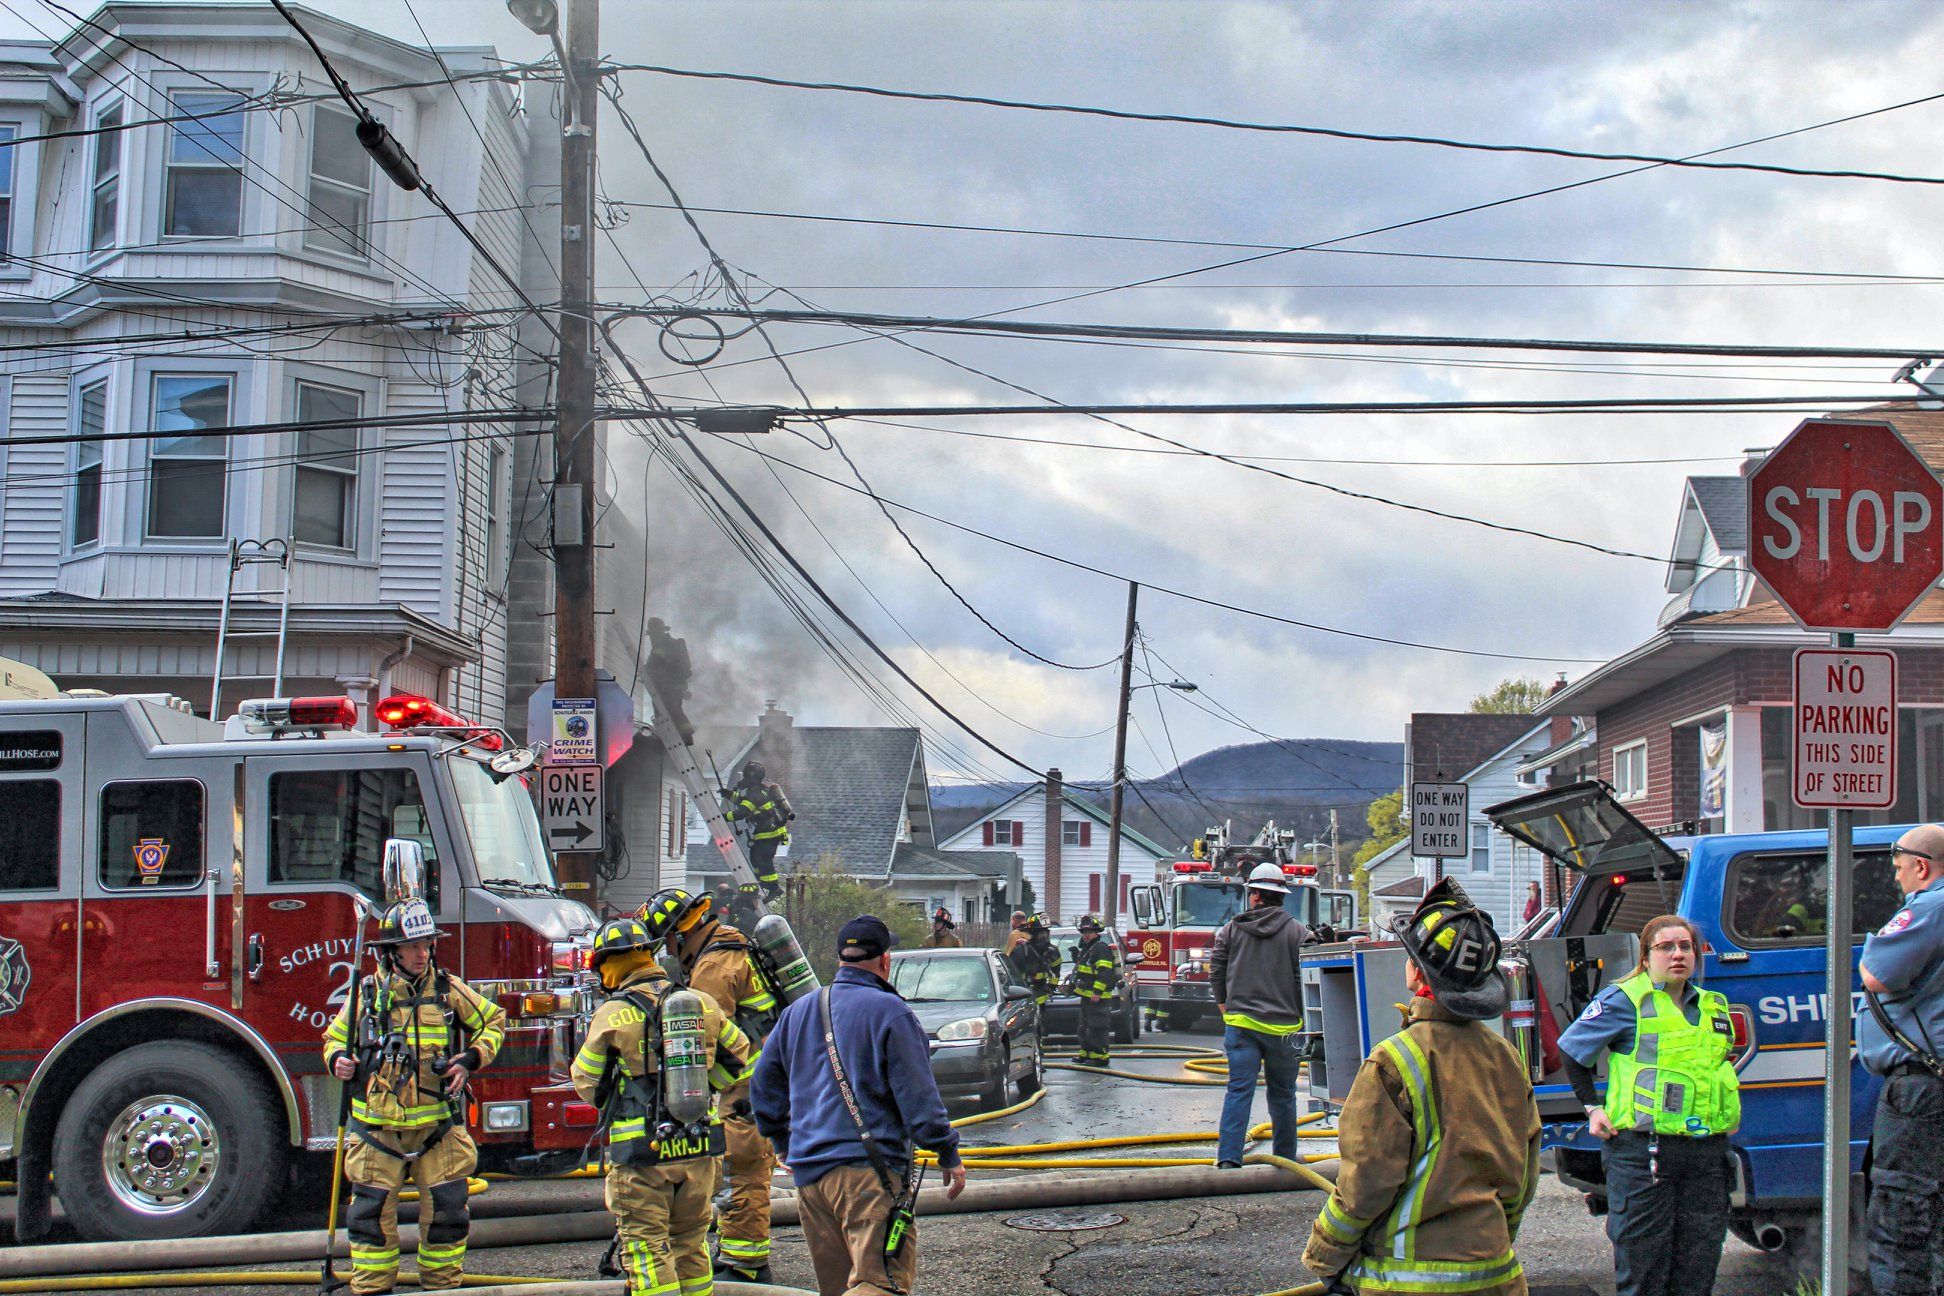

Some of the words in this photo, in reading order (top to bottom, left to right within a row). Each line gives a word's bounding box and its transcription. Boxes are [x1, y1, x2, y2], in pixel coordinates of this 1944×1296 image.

[1762, 485, 1932, 564] STOP
[1827, 664, 1865, 695] NO
[1802, 704, 1889, 735] PARKING
[553, 747, 594, 755] WATCH
[554, 739, 593, 747] CRIME
[1805, 742, 1841, 763] THIS
[1850, 743, 1885, 764] SIDE
[548, 772, 596, 793] ONE
[1806, 772, 1826, 792] OF
[1832, 772, 1884, 794] STREET
[548, 796, 597, 817] WAY
[1416, 791, 1438, 806] ONE
[1442, 792, 1465, 806] WAY
[1420, 812, 1435, 826] DO
[1440, 812, 1461, 827] NOT
[1422, 833, 1458, 848] ENTER
[326, 961, 355, 1005] 2
[671, 1019, 698, 1031] MSA
[1714, 1022, 1728, 1030] EMT
[667, 1055, 692, 1067] MSA
